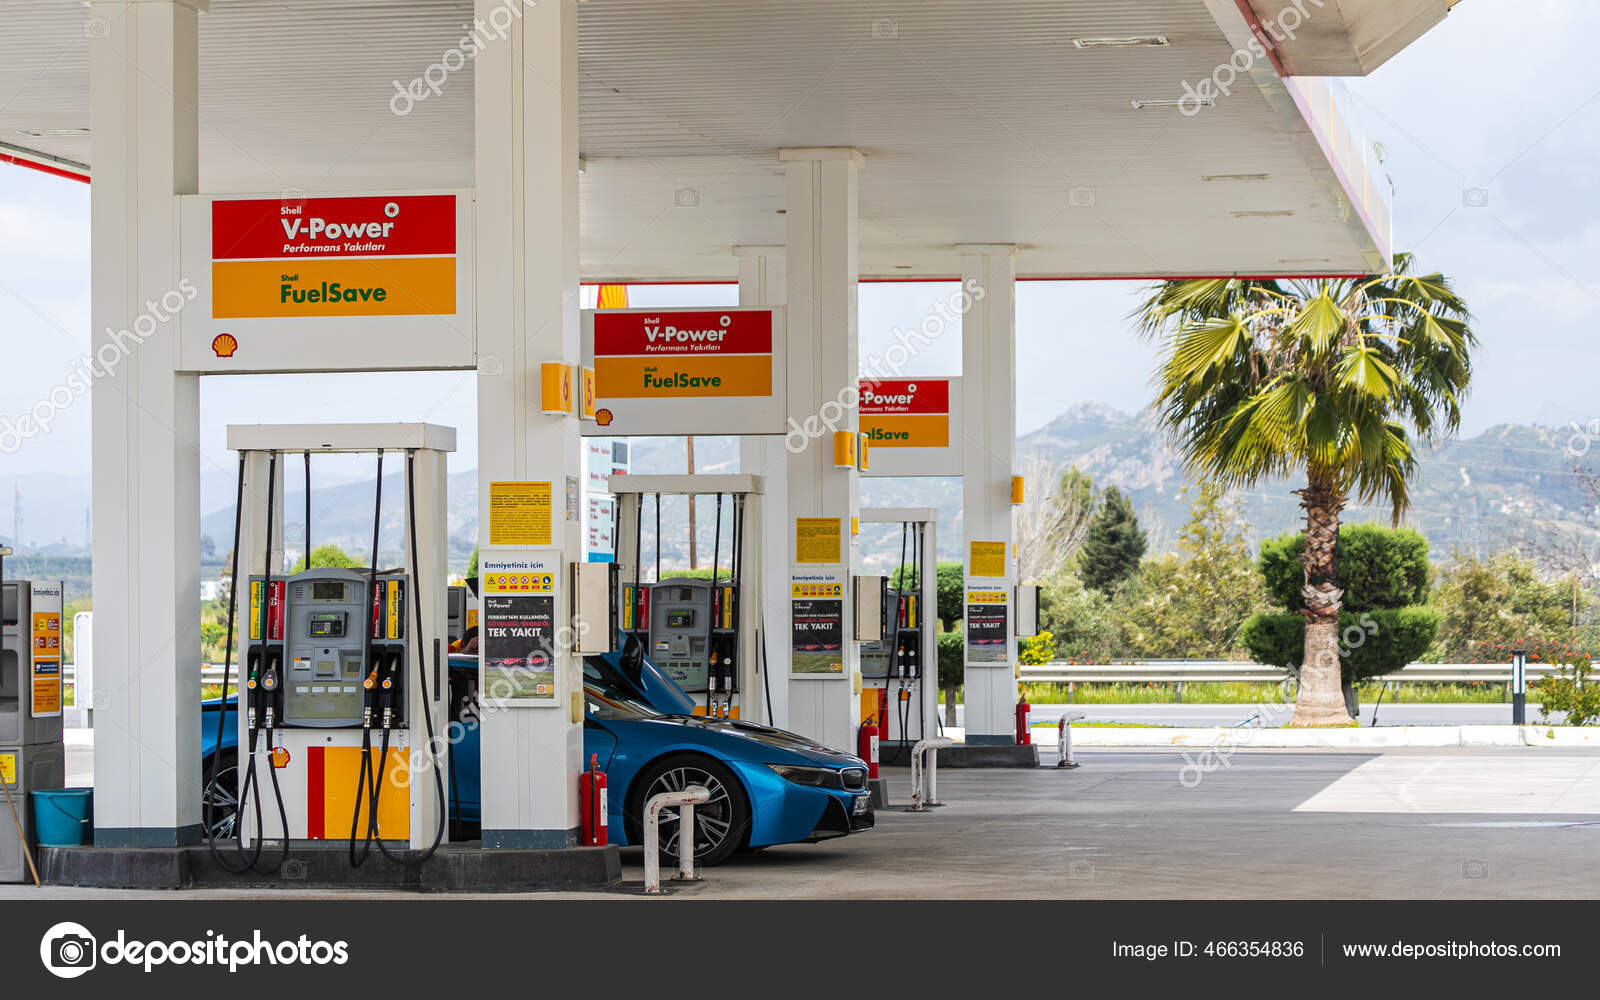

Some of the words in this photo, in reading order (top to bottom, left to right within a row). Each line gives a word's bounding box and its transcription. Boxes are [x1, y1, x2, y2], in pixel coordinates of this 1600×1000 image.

[281, 206, 302, 215] Shell
[281, 218, 395, 240] V-Power
[283, 243, 341, 253] Performans
[344, 242, 386, 252] Yakıtları
[281, 282, 387, 304] FuelSave
[644, 326, 727, 343] V-Power
[645, 344, 688, 352] Performans
[563, 372, 569, 402] 6
[644, 373, 722, 389] FuelSave
[587, 378, 592, 407] 5
[859, 391, 914, 405] -Power
[864, 428, 909, 441] elSave
[484, 562, 528, 570] Emniyetiniz
[488, 628, 507, 637] TEK
[510, 628, 541, 637] YAKIT
[795, 623, 808, 631] TEK
[811, 623, 833, 631] YAKIT
